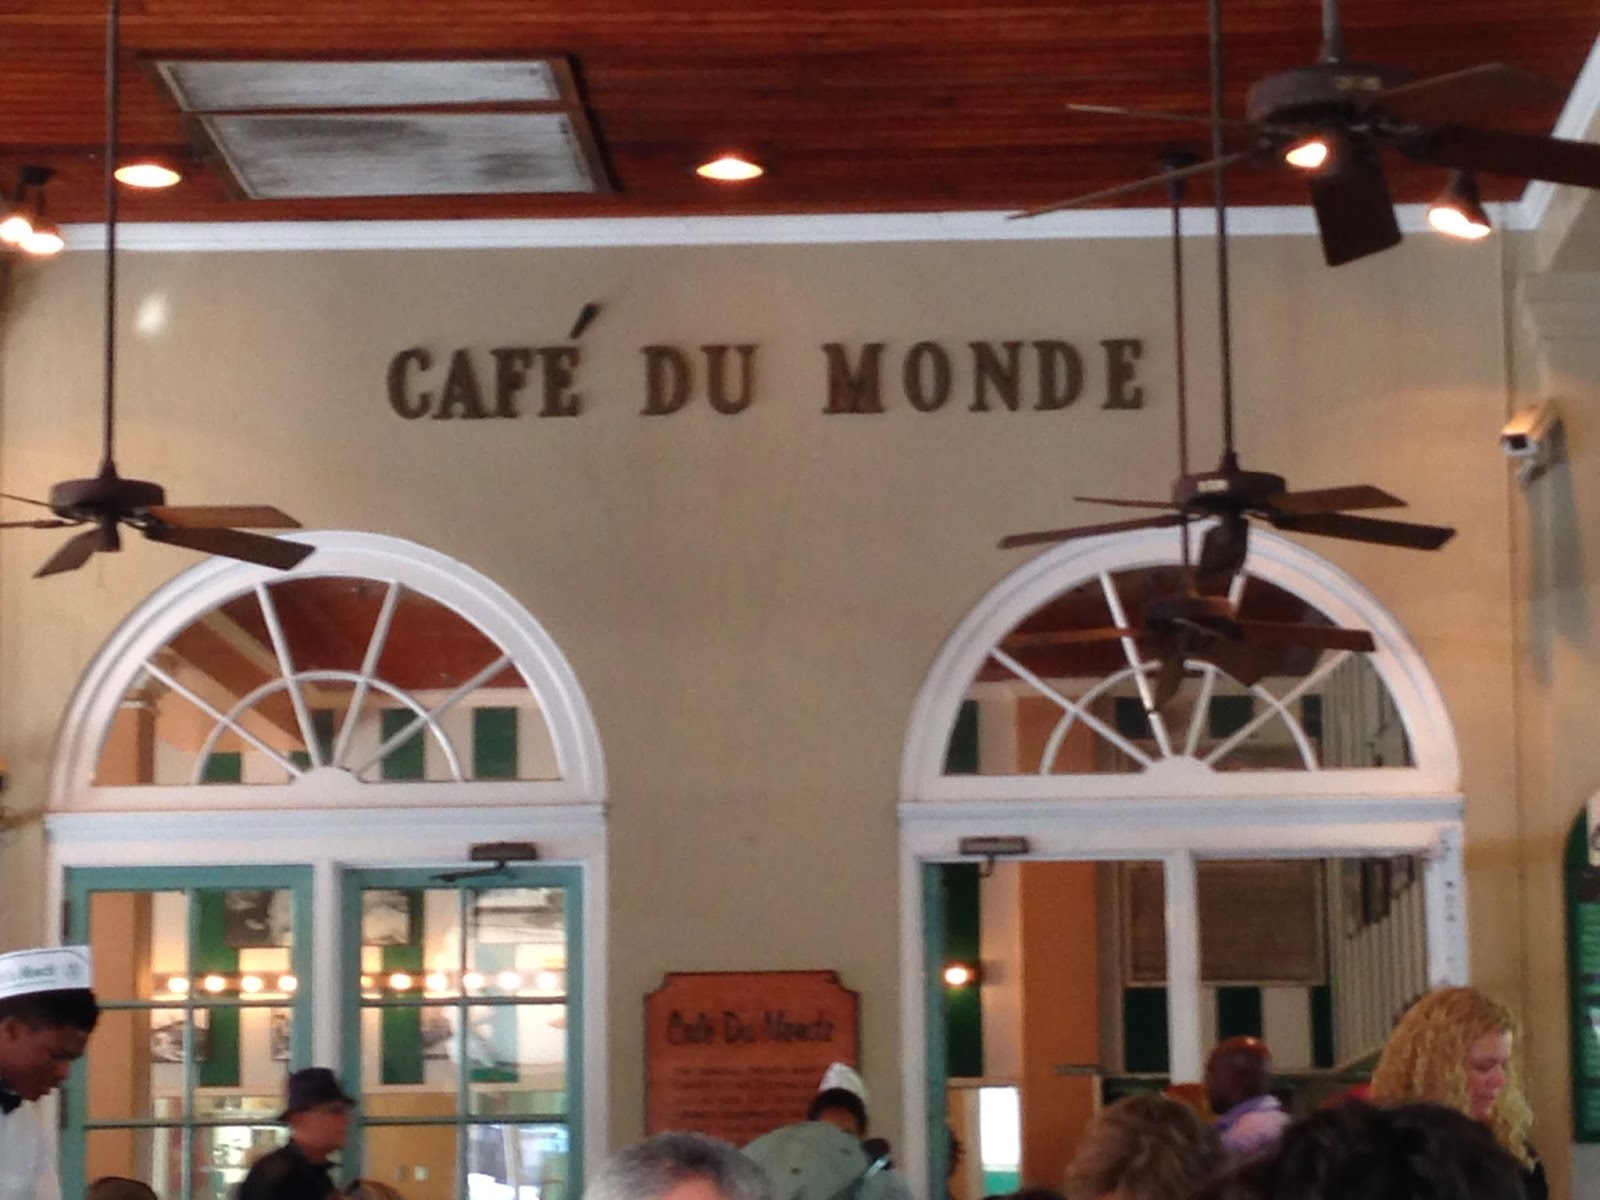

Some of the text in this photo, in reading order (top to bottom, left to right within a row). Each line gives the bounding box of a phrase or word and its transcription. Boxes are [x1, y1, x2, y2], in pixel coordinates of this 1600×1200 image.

[386, 302, 1145, 420] CAFÉ DU MONDE
